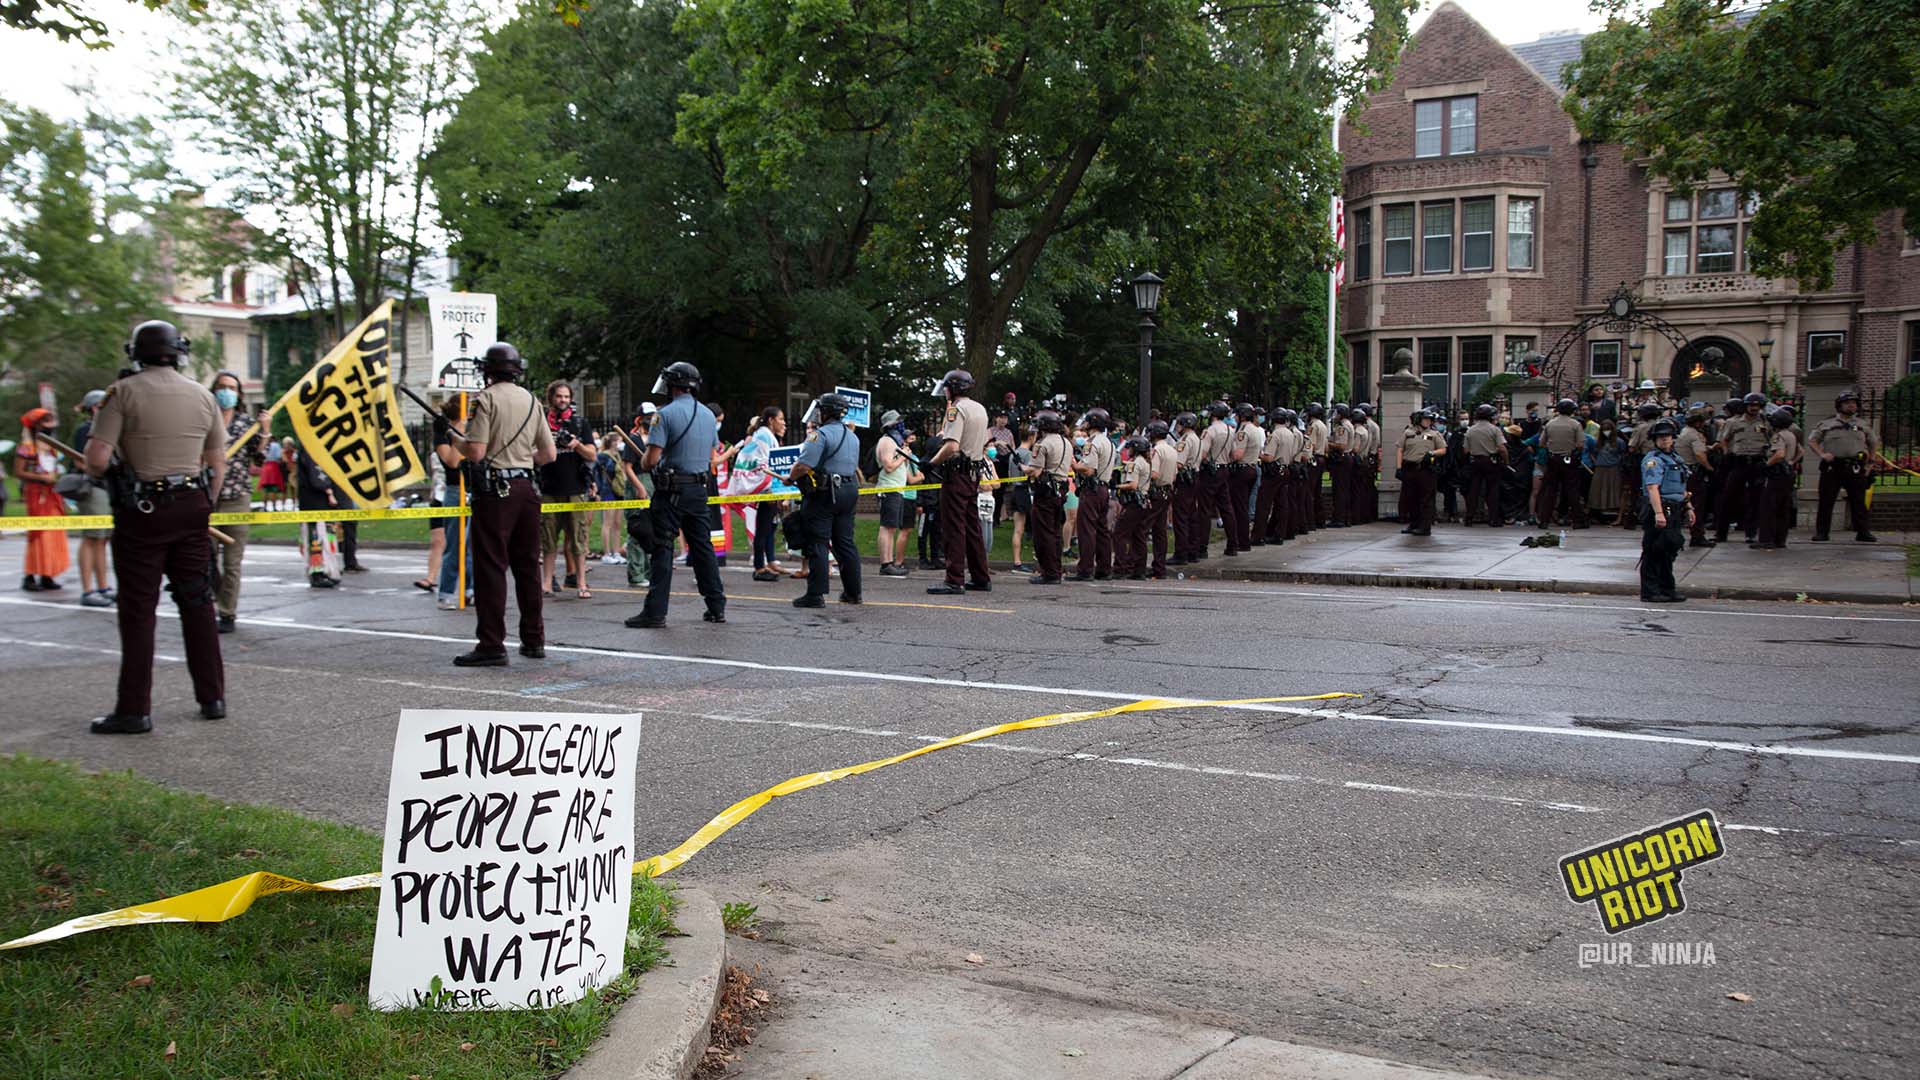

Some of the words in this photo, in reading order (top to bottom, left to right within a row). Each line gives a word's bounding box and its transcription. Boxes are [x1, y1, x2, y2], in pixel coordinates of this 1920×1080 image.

[442, 310, 487, 323] PROTECT
[344, 365, 375, 432] THE
[770, 455, 791, 465] LINE
[420, 722, 622, 780] INDIGEOUS
[398, 790, 560, 864] PEOPLE
[557, 787, 613, 853] ARE
[443, 914, 596, 983] WATER
[527, 985, 565, 1009] are
